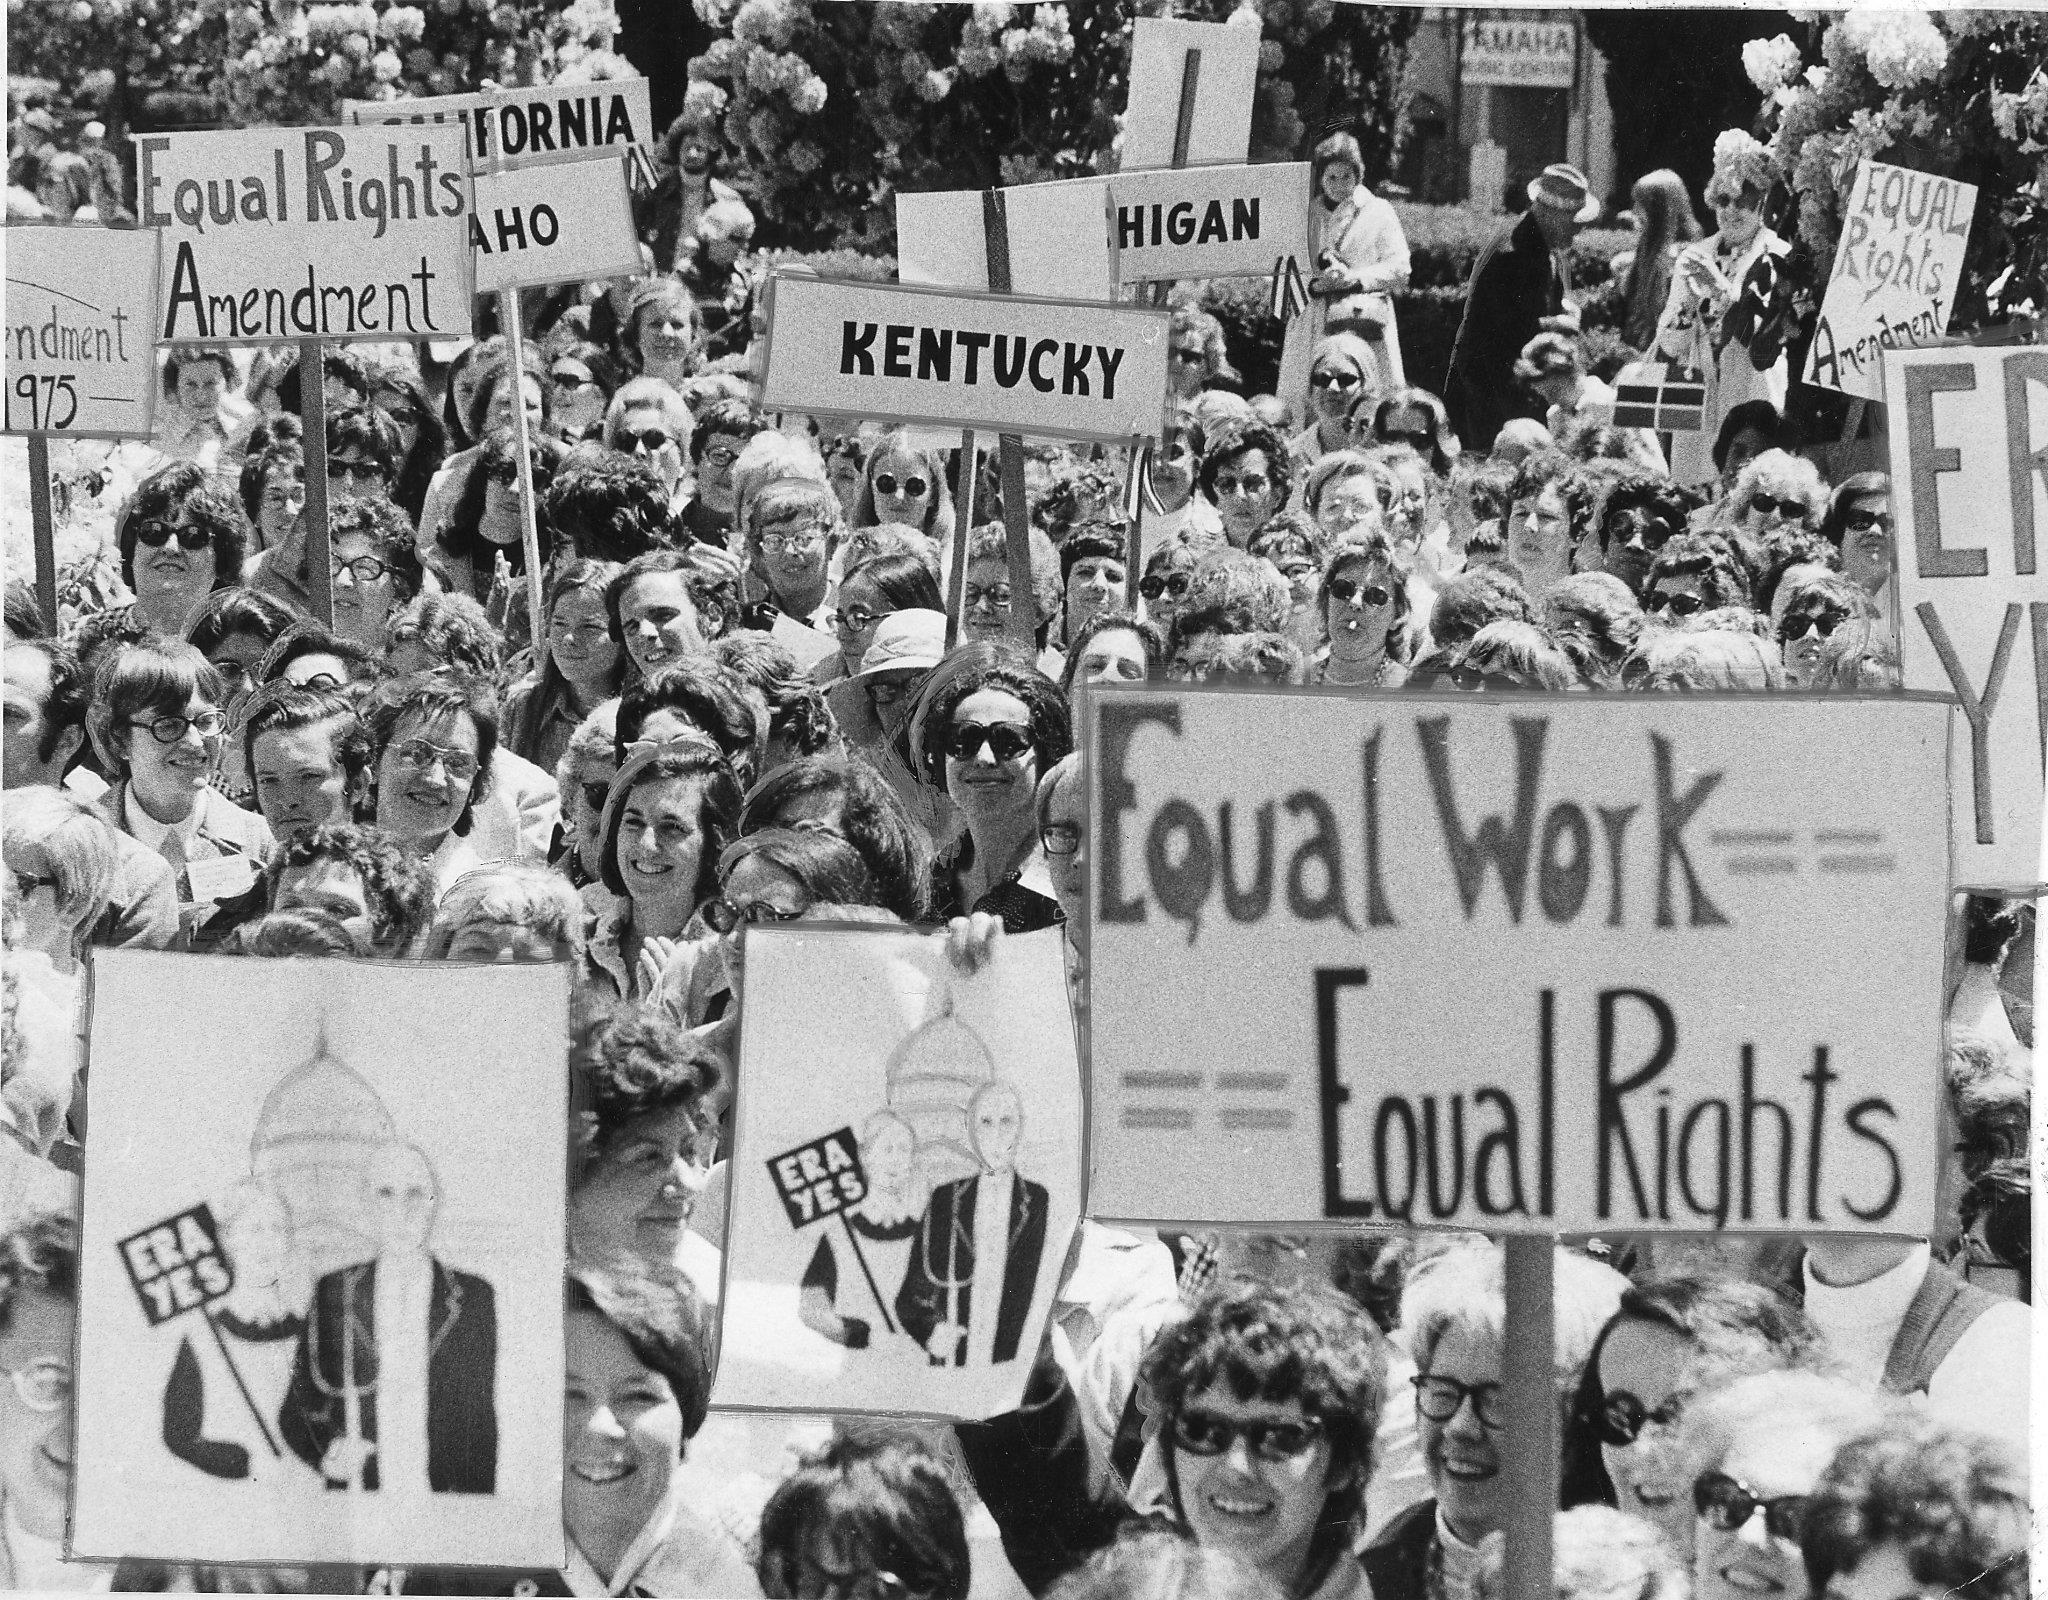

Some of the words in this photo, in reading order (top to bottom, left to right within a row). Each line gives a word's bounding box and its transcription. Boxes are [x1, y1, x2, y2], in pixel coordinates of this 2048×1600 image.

[142, 136, 289, 235] Equal
[304, 129, 466, 239] Rights
[1106, 198, 1260, 249] HIGAN
[1860, 165, 1969, 237] EQUAL
[163, 240, 440, 339] Amendment
[1831, 214, 1944, 306] Rights
[839, 319, 1125, 401] KENTUCKY
[1809, 296, 1944, 391] Amendment
[1098, 702, 1397, 945] Equal
[1416, 713, 1733, 930] Work
[1313, 965, 1556, 1228] Equal
[1597, 986, 1904, 1232] Rights
[775, 1137, 854, 1191] ERA
[789, 1170, 864, 1221] YES
[125, 1215, 215, 1281] ERA
[142, 1255, 230, 1318] YES
